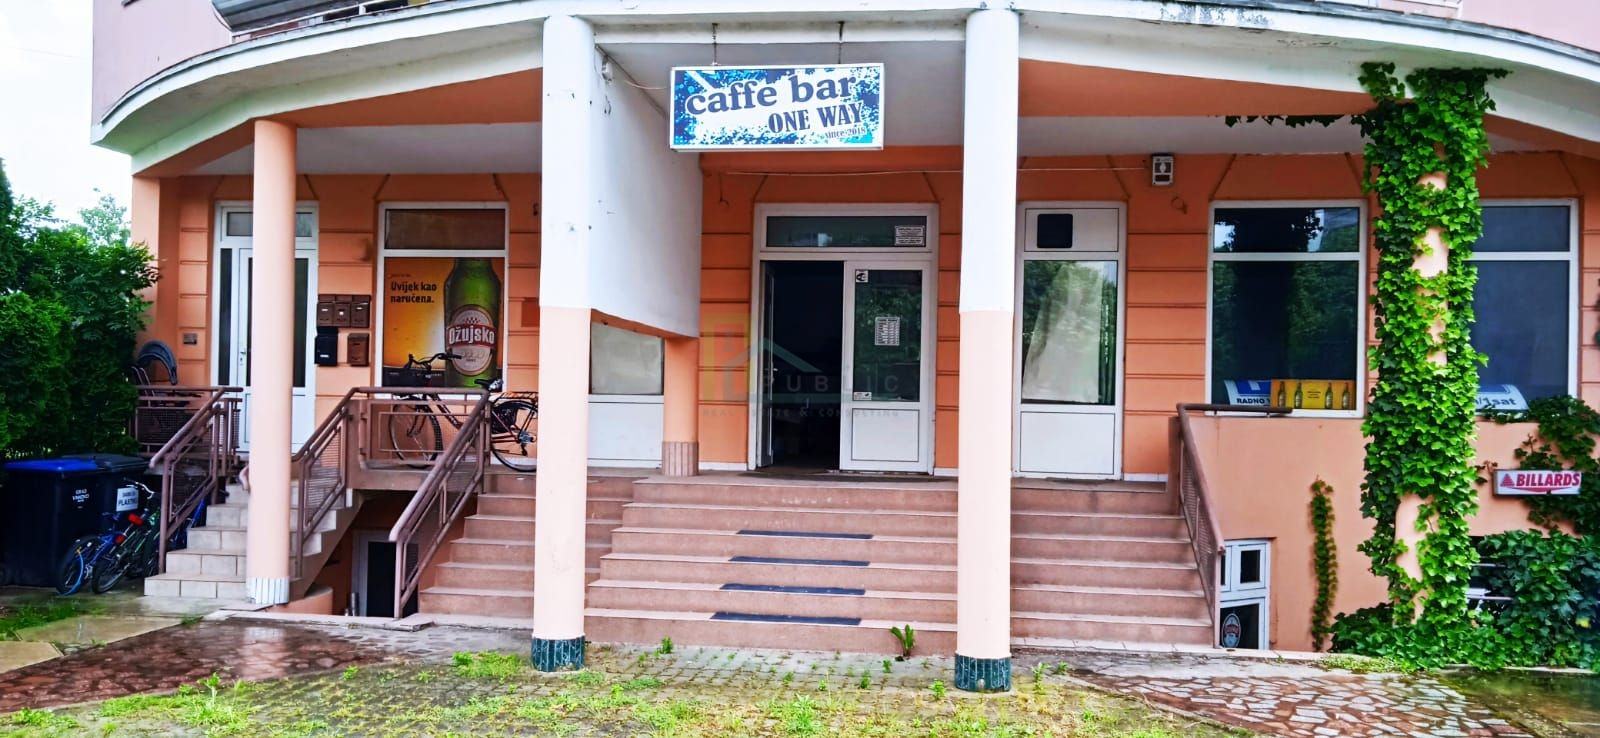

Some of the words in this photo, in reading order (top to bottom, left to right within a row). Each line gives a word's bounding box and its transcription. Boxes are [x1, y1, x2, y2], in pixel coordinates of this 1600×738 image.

[686, 81, 777, 115] caffe
[788, 74, 857, 104] bar
[768, 109, 811, 134] ONE
[816, 102, 863, 128] WAY
[391, 281, 418, 293] Uvijek
[420, 281, 437, 291] kao
[448, 325, 495, 345] Ožujsko
[1516, 473, 1580, 487] BILLARDS
